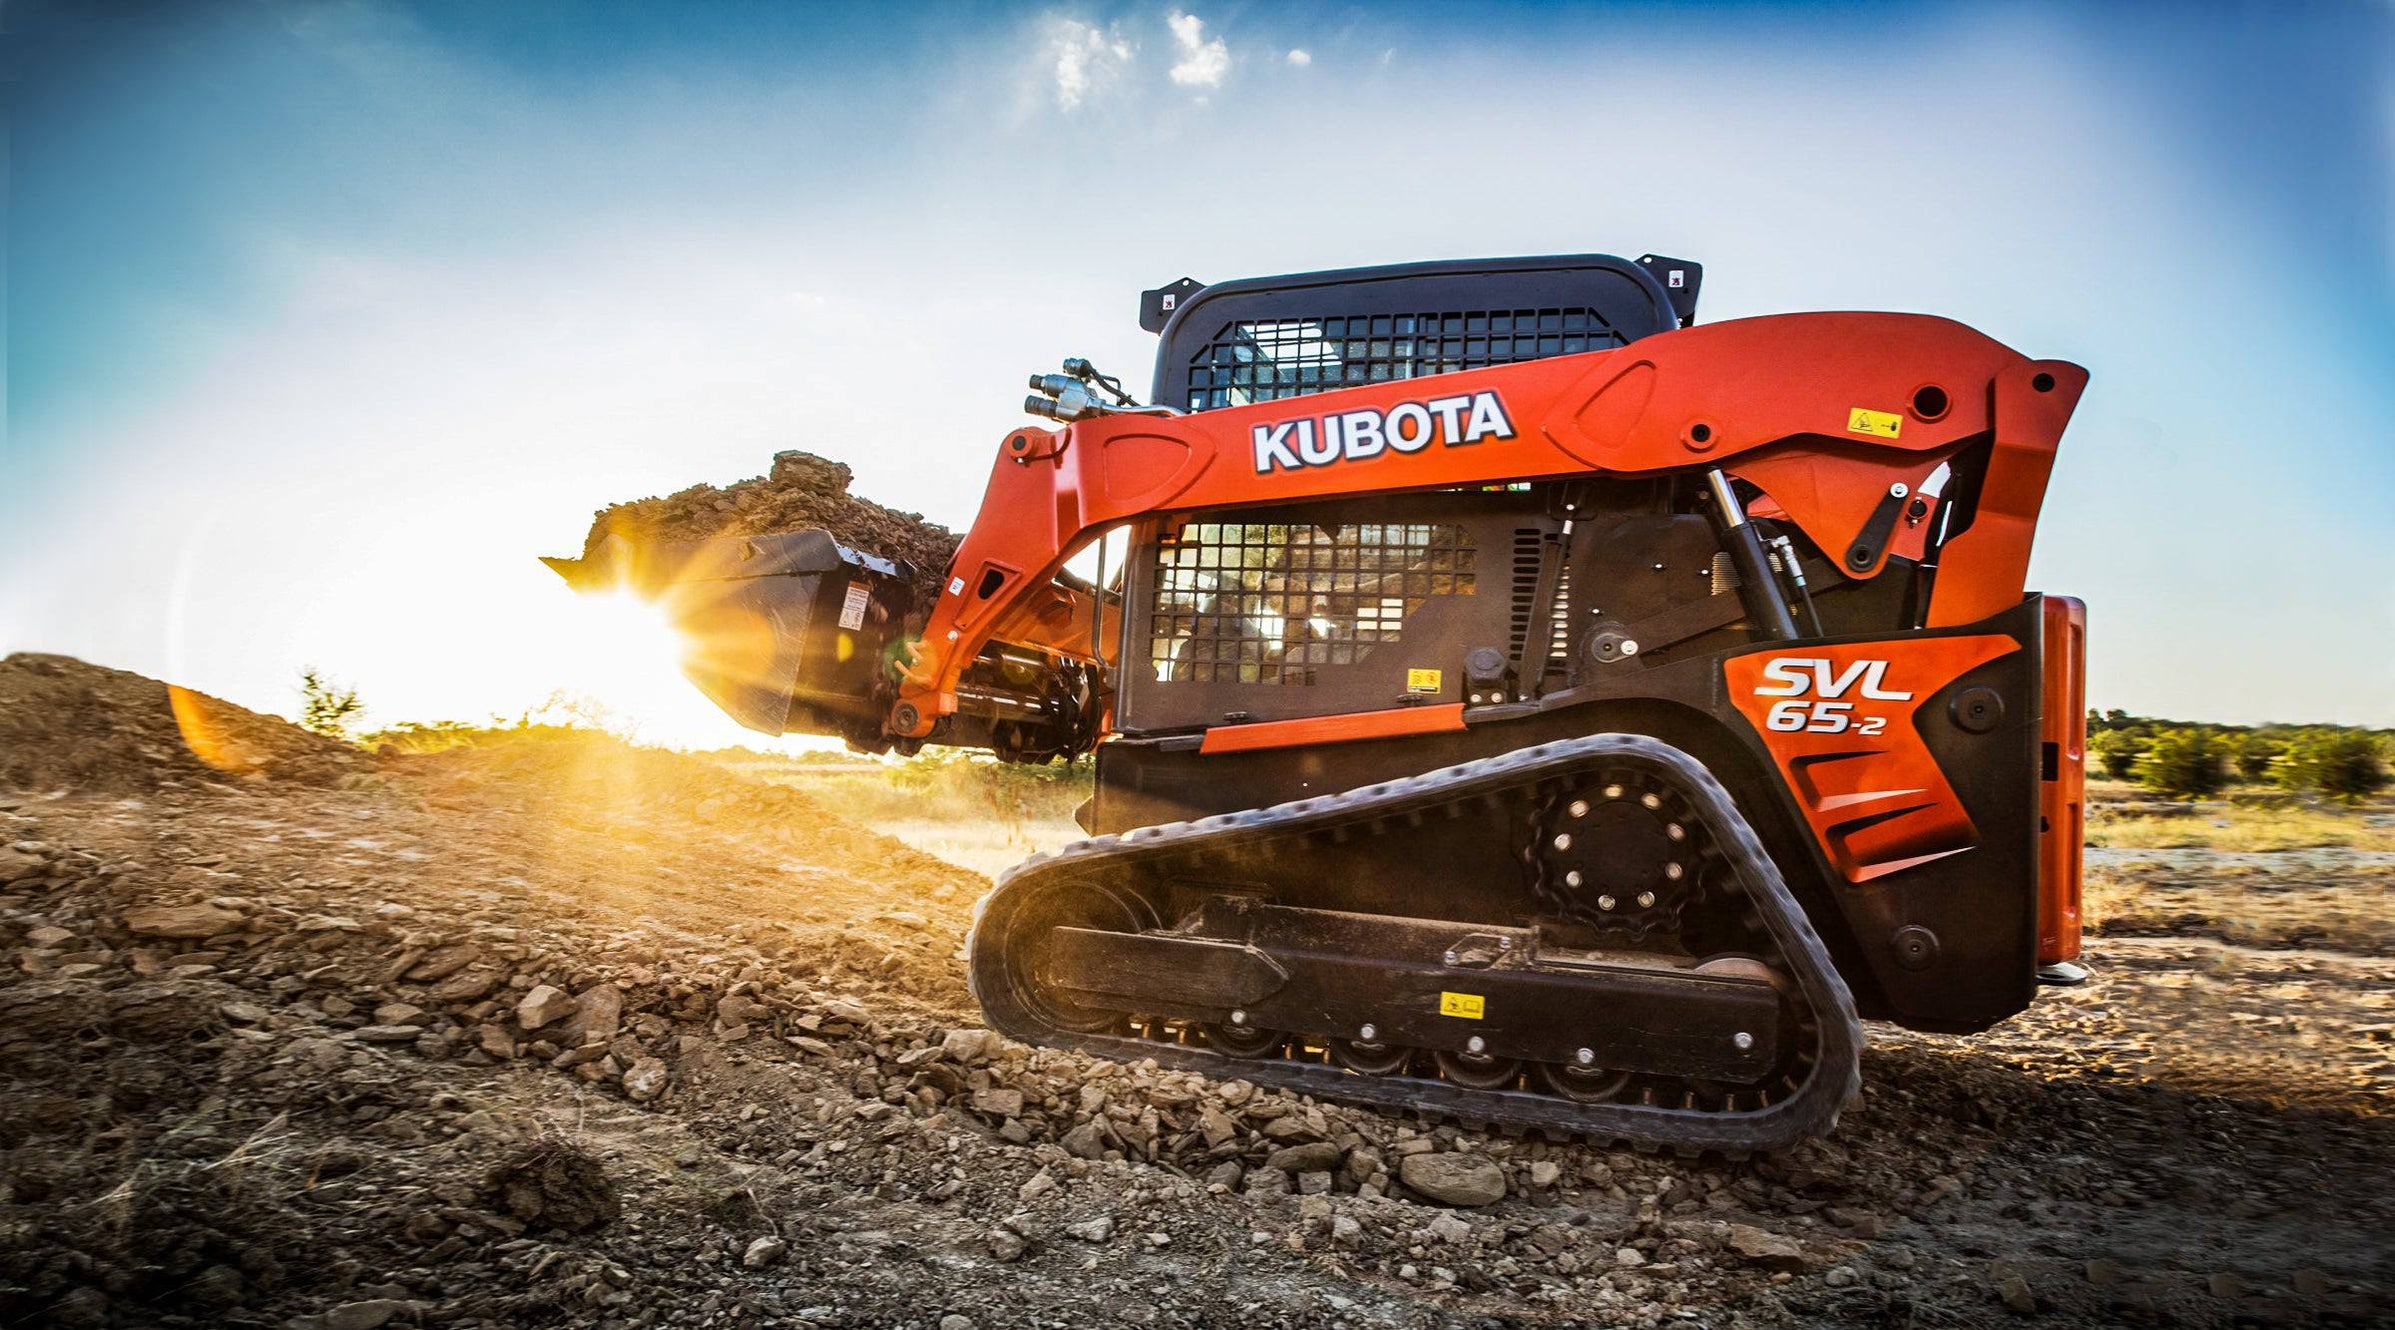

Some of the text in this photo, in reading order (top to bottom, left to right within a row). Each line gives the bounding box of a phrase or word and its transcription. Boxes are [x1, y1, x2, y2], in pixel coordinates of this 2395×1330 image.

[1253, 392, 1515, 472] KUBOTA
[1753, 657, 1914, 700] SVL
[1766, 700, 1888, 735] 65-2
